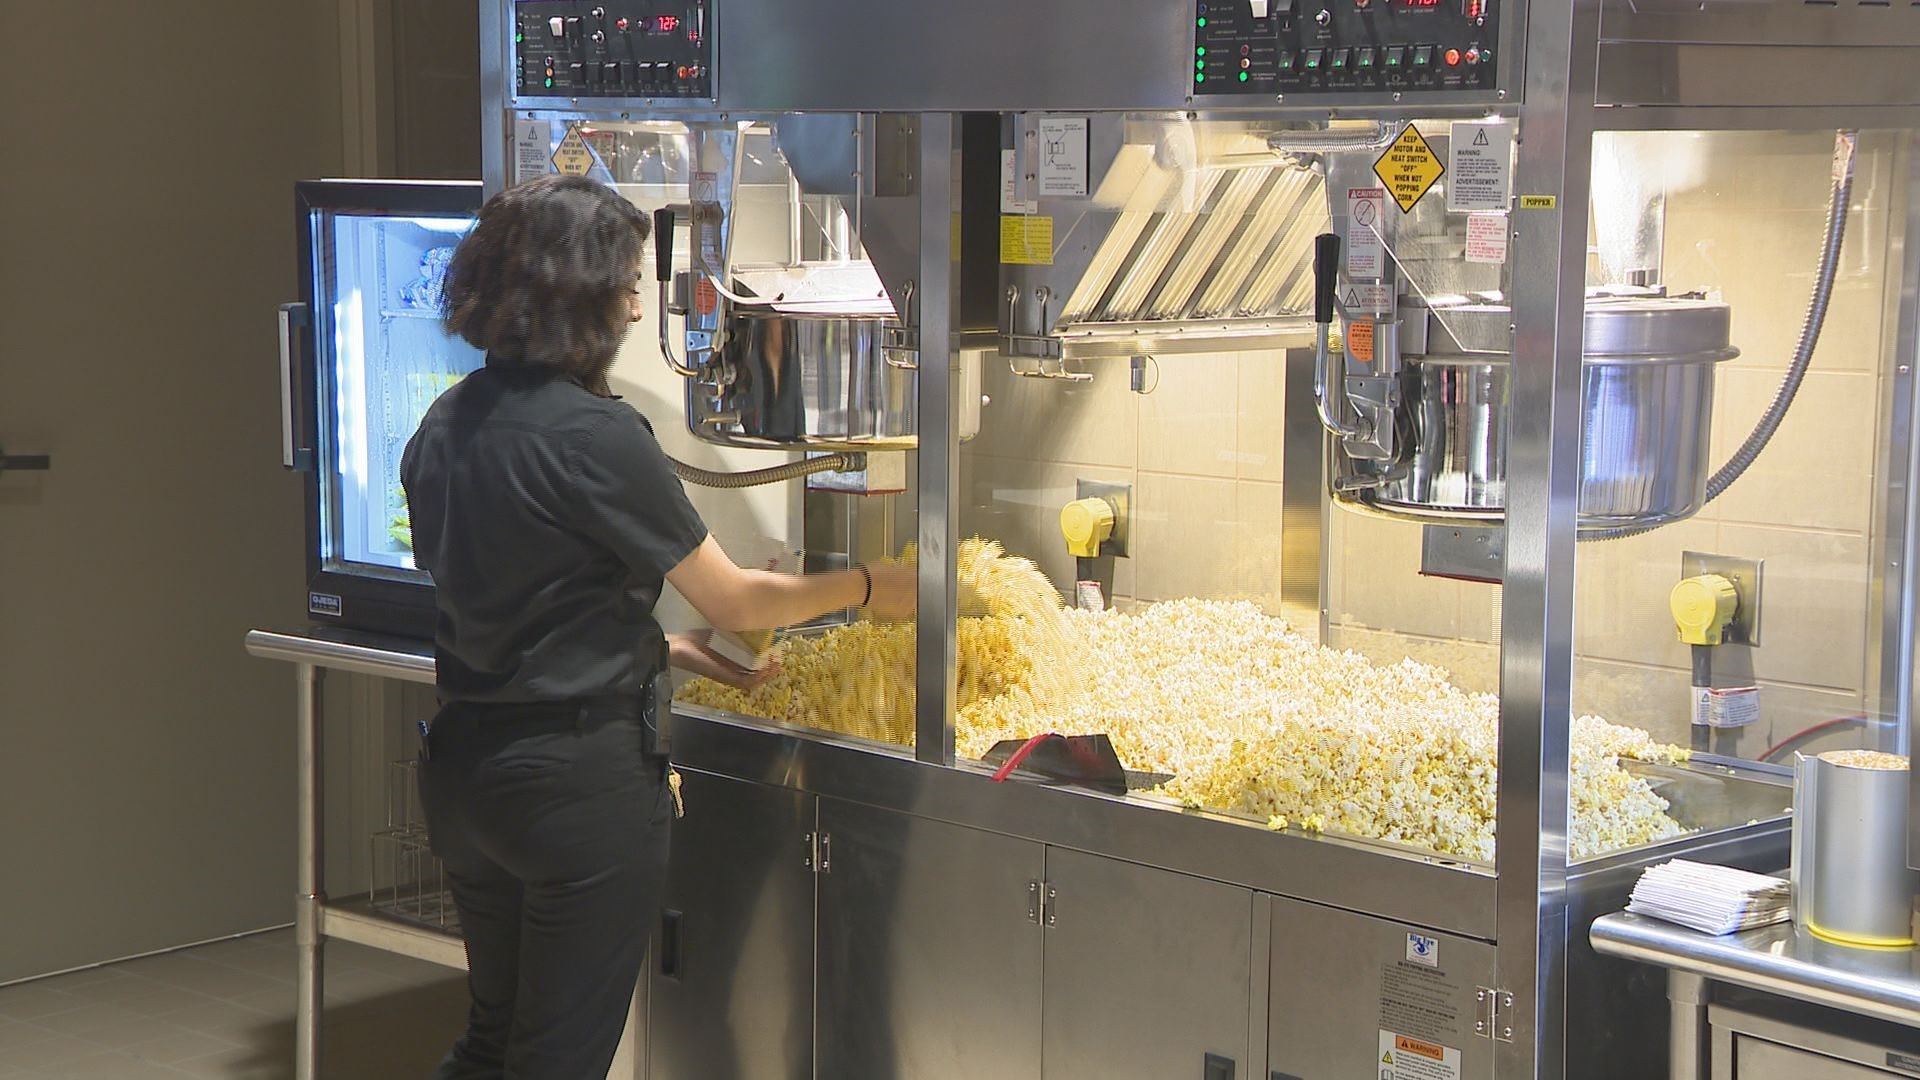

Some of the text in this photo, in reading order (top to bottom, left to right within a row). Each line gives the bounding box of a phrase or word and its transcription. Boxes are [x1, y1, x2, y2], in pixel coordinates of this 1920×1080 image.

[658, 16, 675, 31] 72F
[1394, 145, 1413, 153] MOTOR
[1391, 155, 1428, 163] HEAT SWITCH
[1394, 174, 1410, 182] WHEN
[1395, 184, 1420, 192] POPPING
[1526, 198, 1551, 206] POPPER
[1410, 1041, 1440, 1056] WARNING
